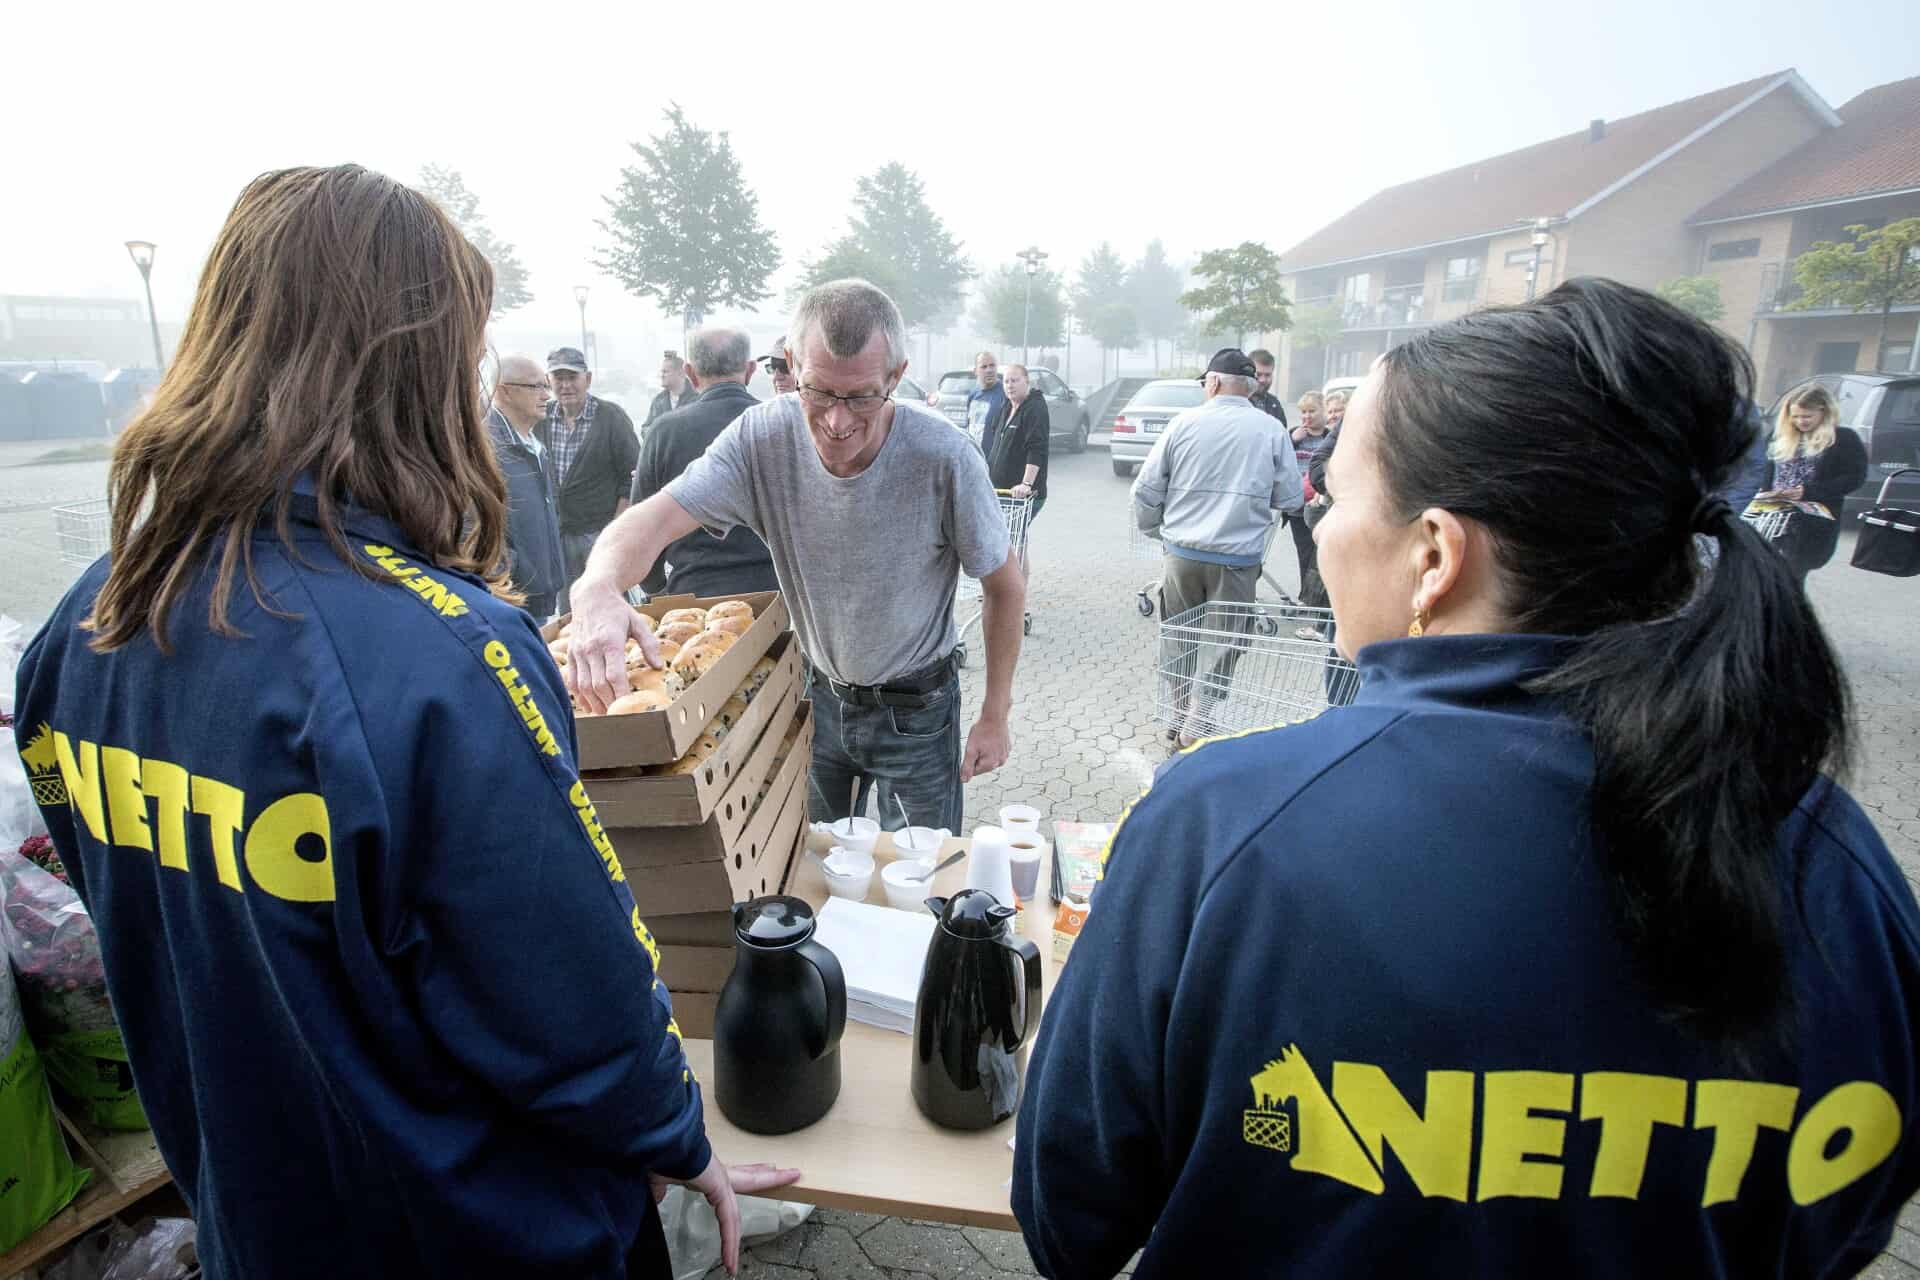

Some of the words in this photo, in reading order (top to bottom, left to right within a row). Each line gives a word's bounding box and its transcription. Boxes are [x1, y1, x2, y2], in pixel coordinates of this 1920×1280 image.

[484, 640, 555, 750] NETTO
[53, 730, 336, 902] NETTO
[1332, 1061, 1902, 1207] NETTO
